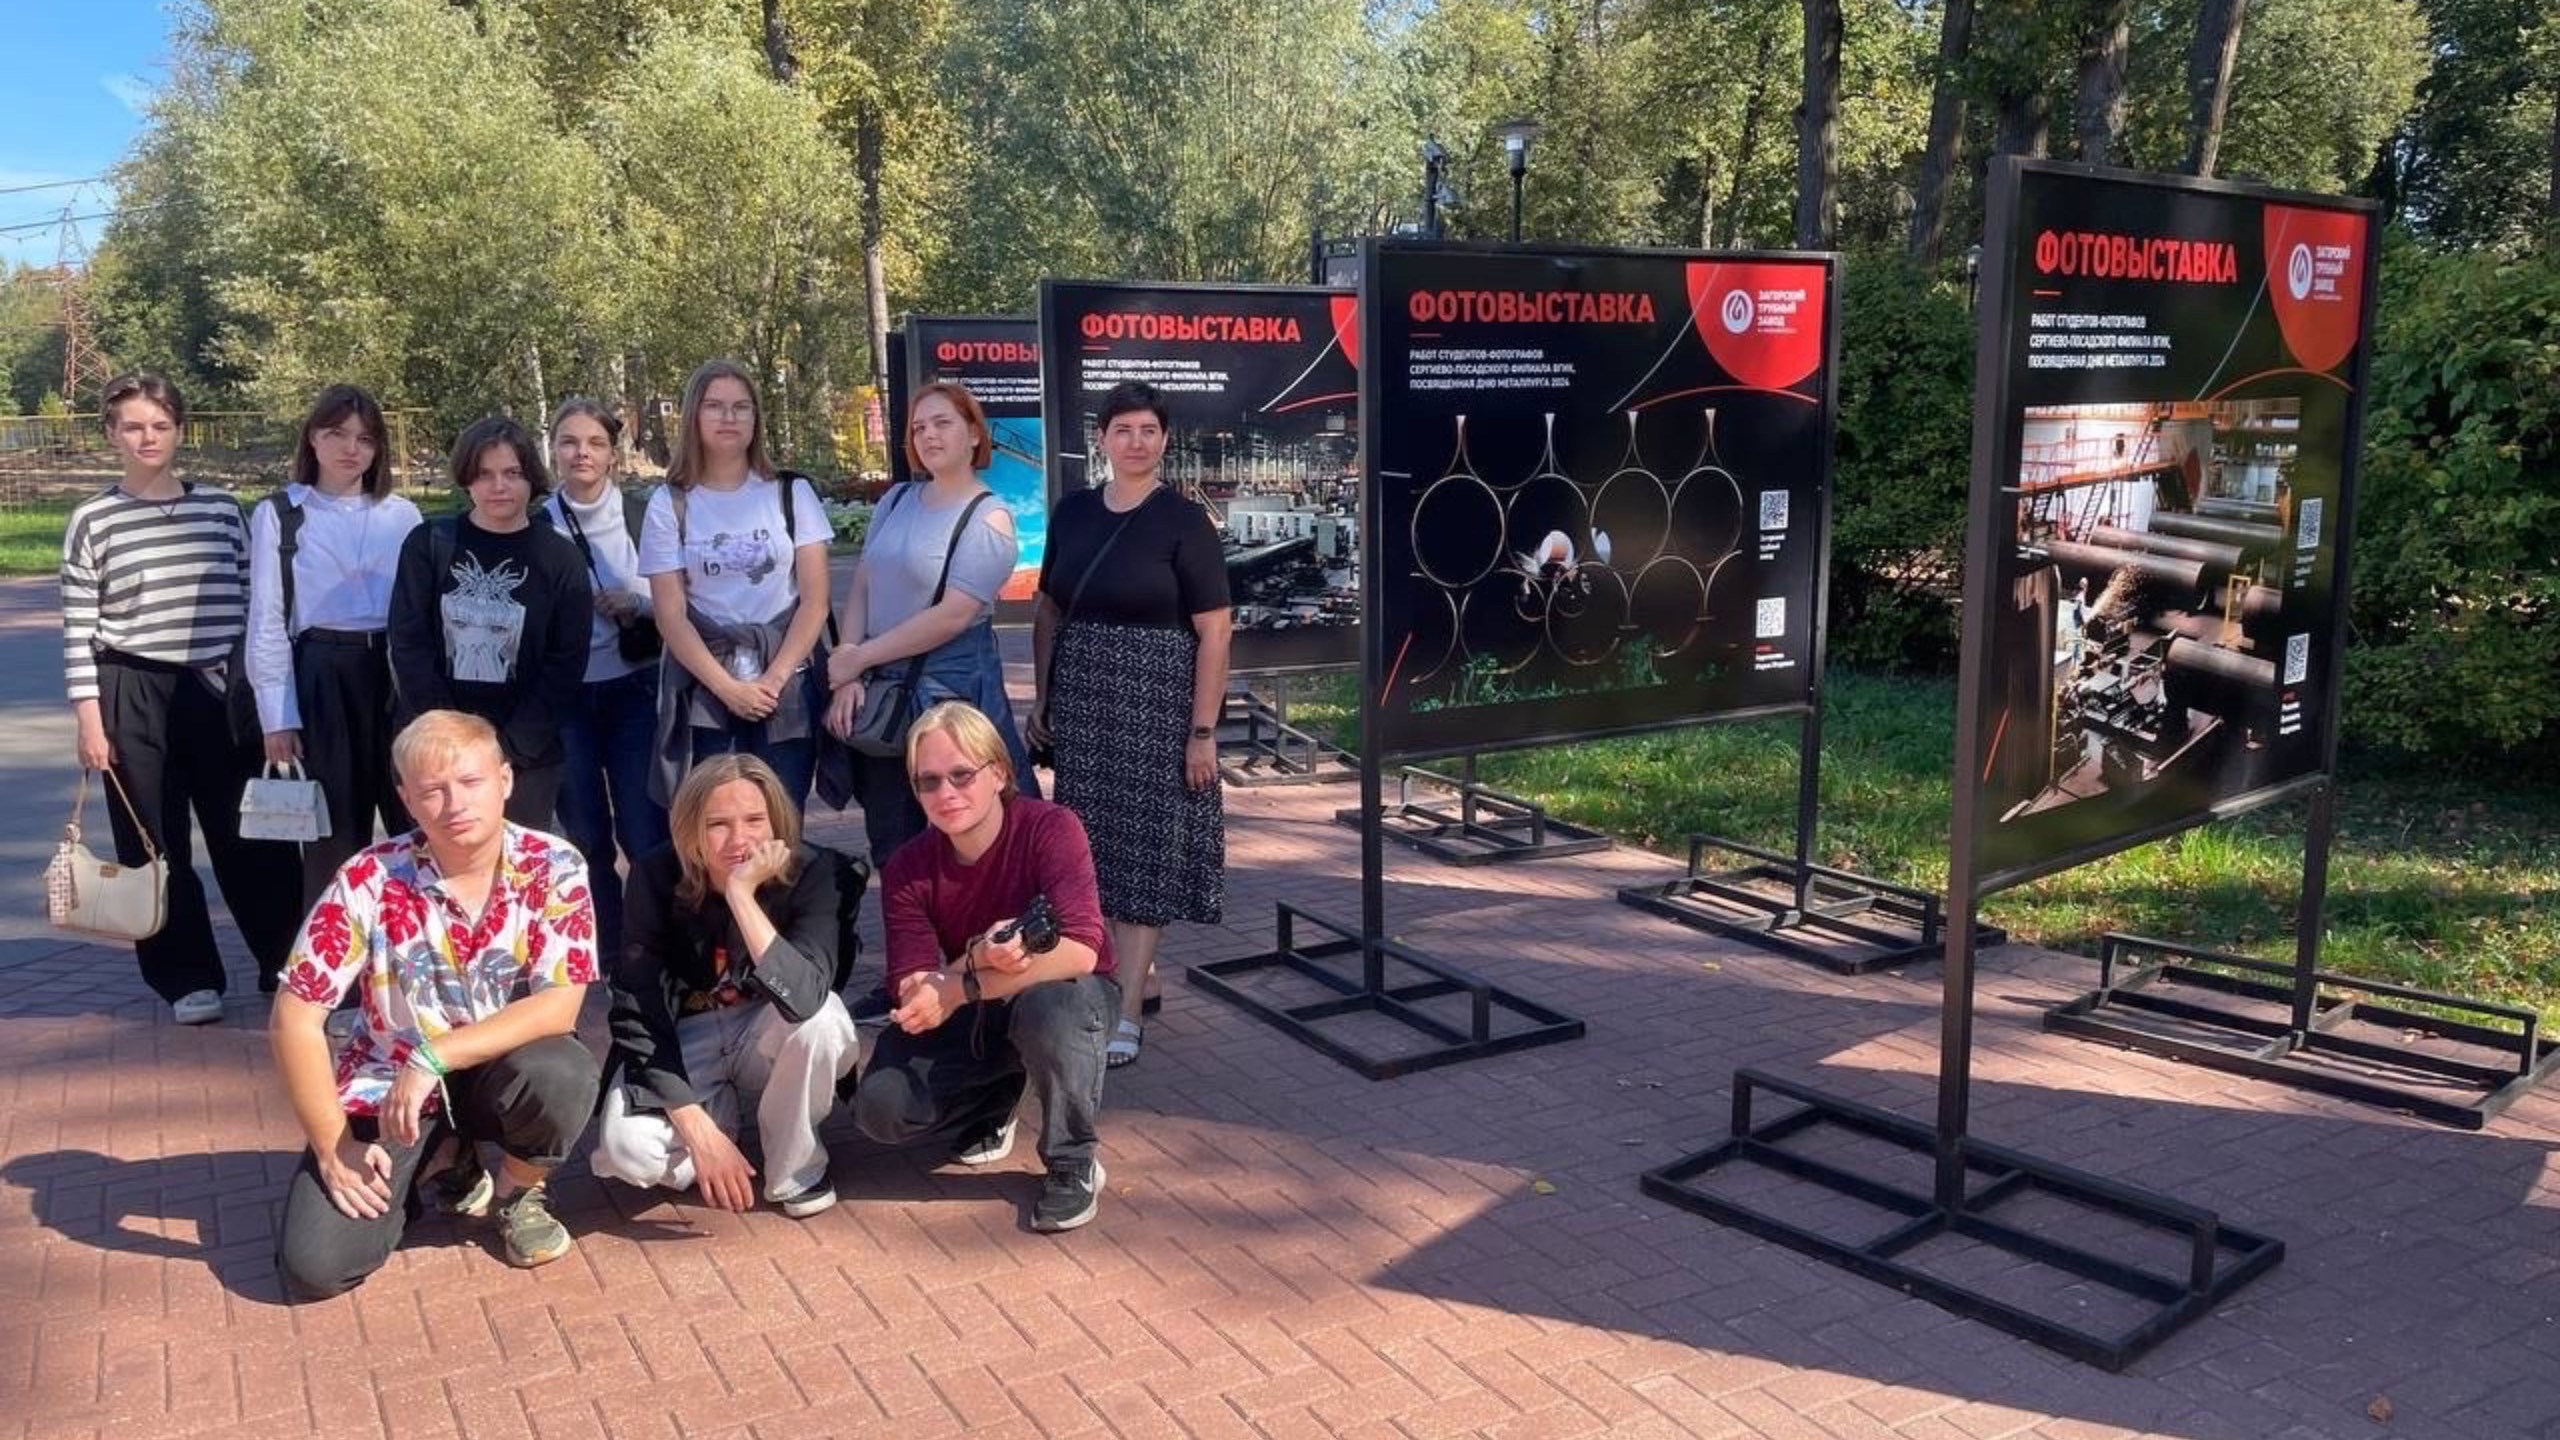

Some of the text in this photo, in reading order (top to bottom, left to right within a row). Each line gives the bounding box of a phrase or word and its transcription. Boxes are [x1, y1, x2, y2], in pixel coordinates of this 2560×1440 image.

[2035, 230, 2237, 283] ФОТОВЫСТАВКА
[1409, 288, 1655, 323] ФОТОВЫСТАВКА
[1081, 313, 1301, 342] ФОТОВЫСТАВКА
[2031, 313, 2056, 328] РАБОТ
[937, 342, 1038, 362] ФОТОВЫ
[1409, 349, 1544, 361] РАБОТ СТУДЕНТОВ-ФОТОГРАФОВ
[1082, 359, 1106, 369] РАБОТ
[1409, 363, 1509, 375] СЕРГИЕВО-ПОСАДСКОГО
[1511, 363, 1551, 373] ФИЛИАЛА
[1409, 379, 1475, 390] ПОСВЯЩЕННАЯ
[1476, 379, 1496, 390] ДНЮ
